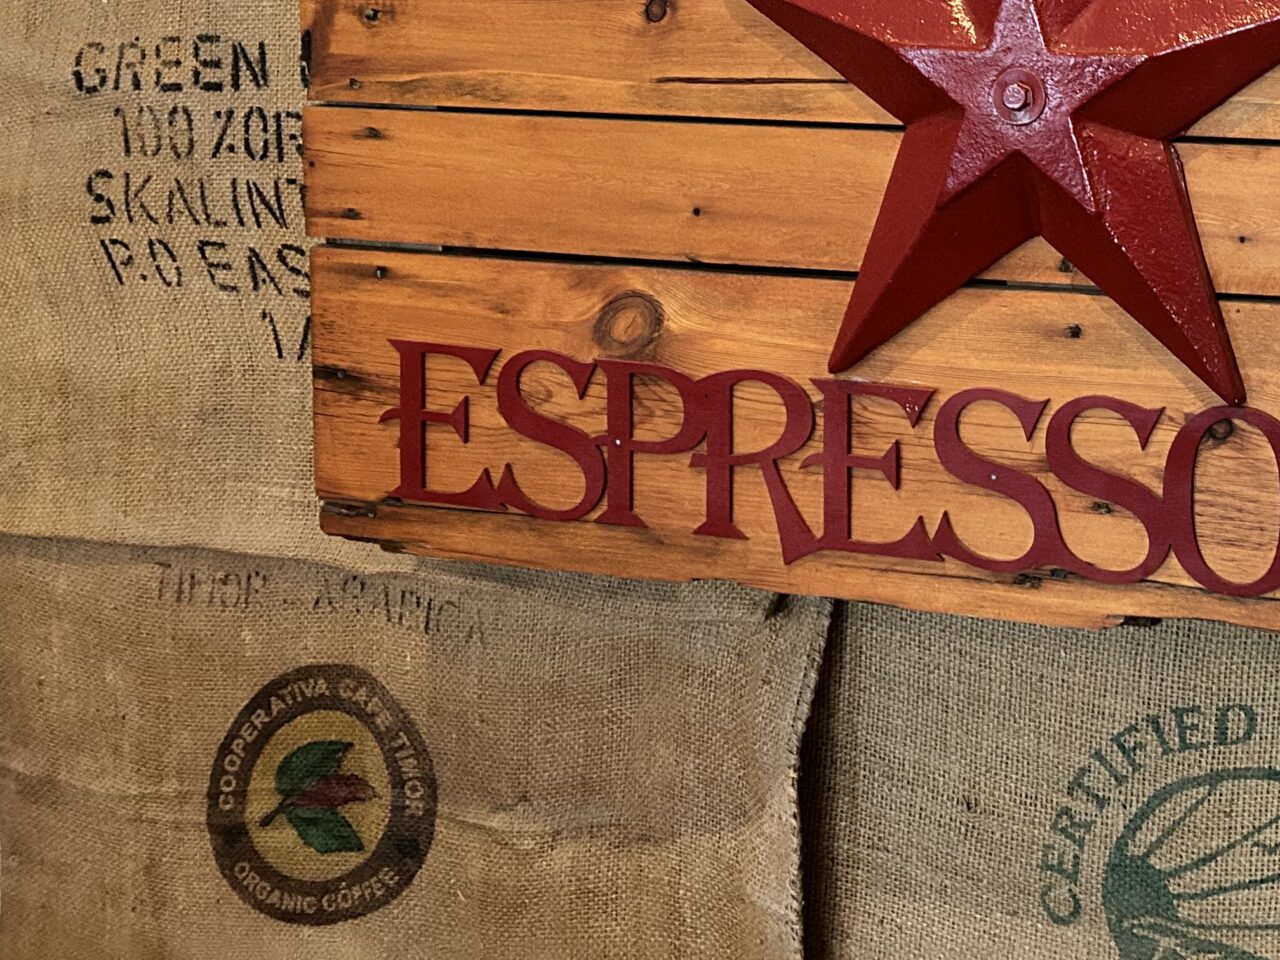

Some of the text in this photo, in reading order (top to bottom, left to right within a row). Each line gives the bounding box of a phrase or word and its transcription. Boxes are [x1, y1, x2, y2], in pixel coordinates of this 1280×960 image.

[72, 33, 269, 93] GREEN
[218, 679, 330, 811] COOPERATIVA
[1040, 704, 1258, 927] CERTIFIED
[234, 861, 318, 915] ORGANIC
